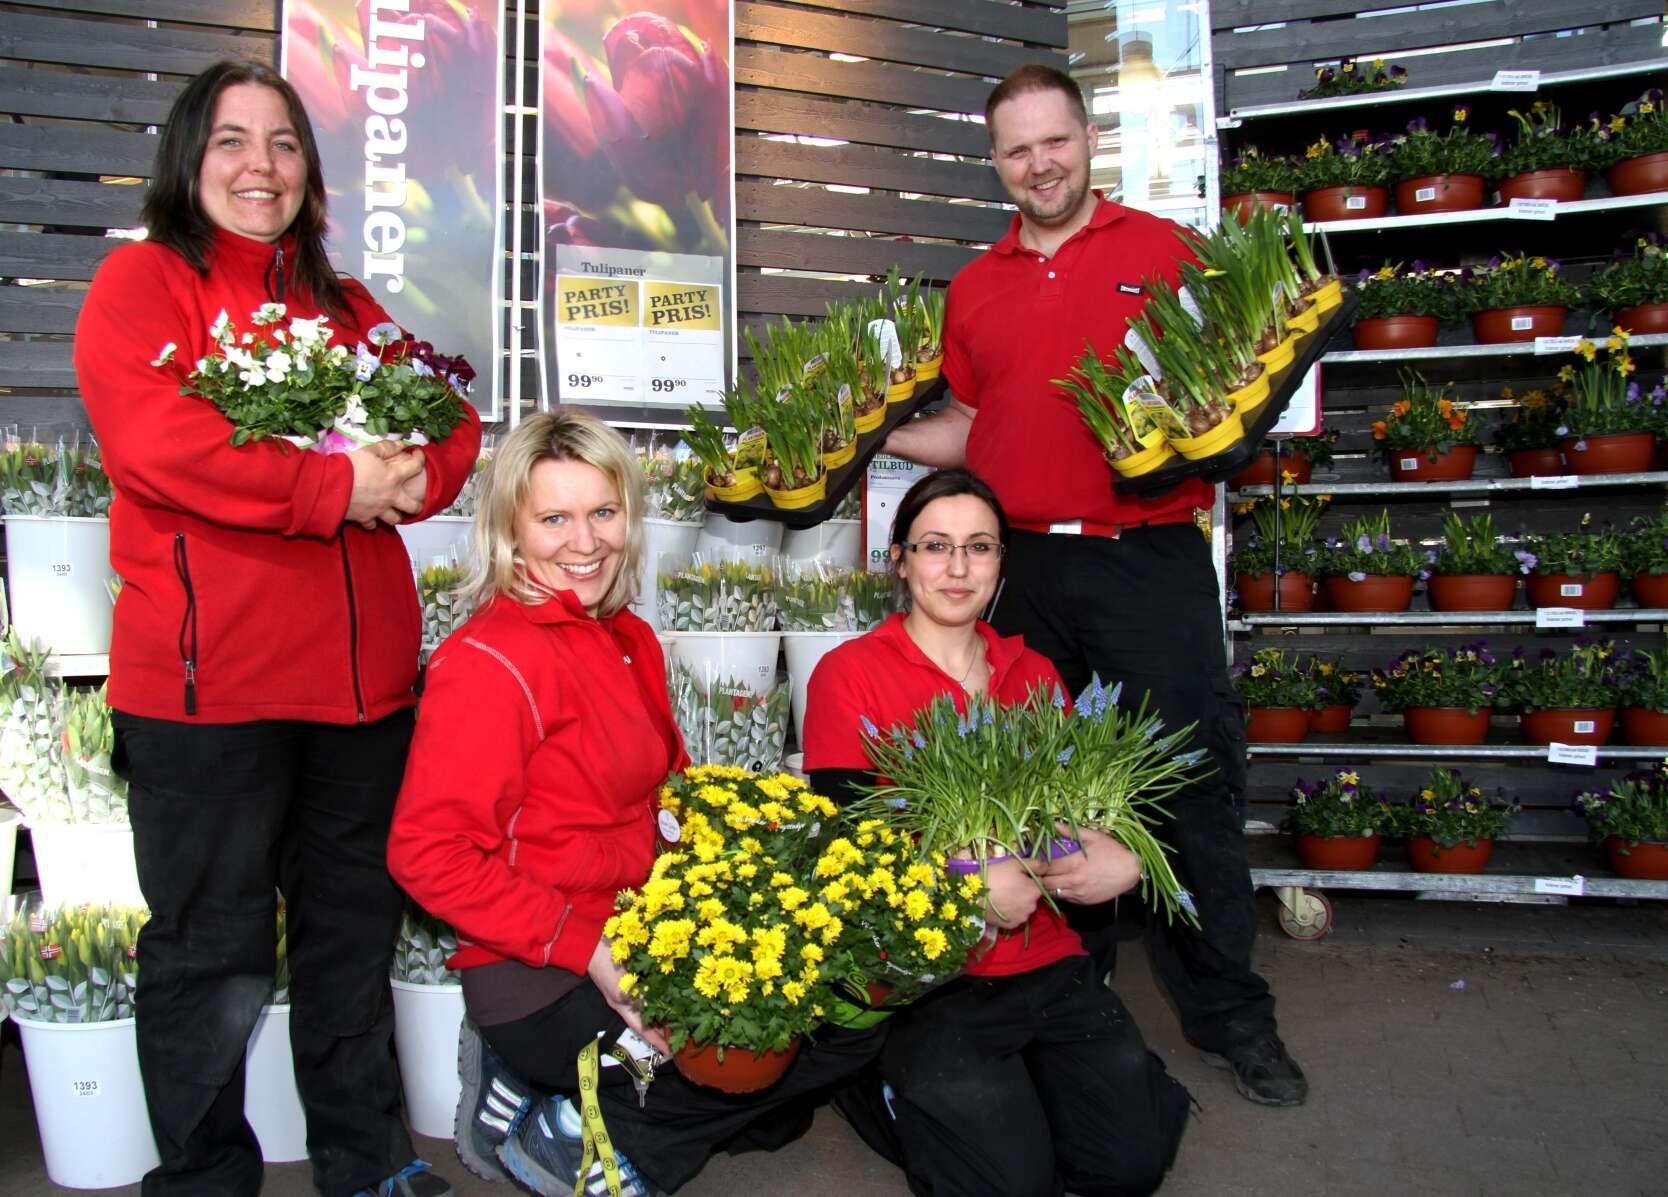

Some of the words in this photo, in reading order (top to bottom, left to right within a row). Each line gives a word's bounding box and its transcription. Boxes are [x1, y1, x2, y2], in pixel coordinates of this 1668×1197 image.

[581, 262, 646, 277] Tulipaner
[564, 284, 626, 304] PARTY
[650, 290, 708, 308] PARTY
[567, 299, 630, 321] PRIS!
[652, 304, 712, 326] PRIS!
[872, 460, 914, 471] TILBUD
[74, 1081, 97, 1090] 1393
